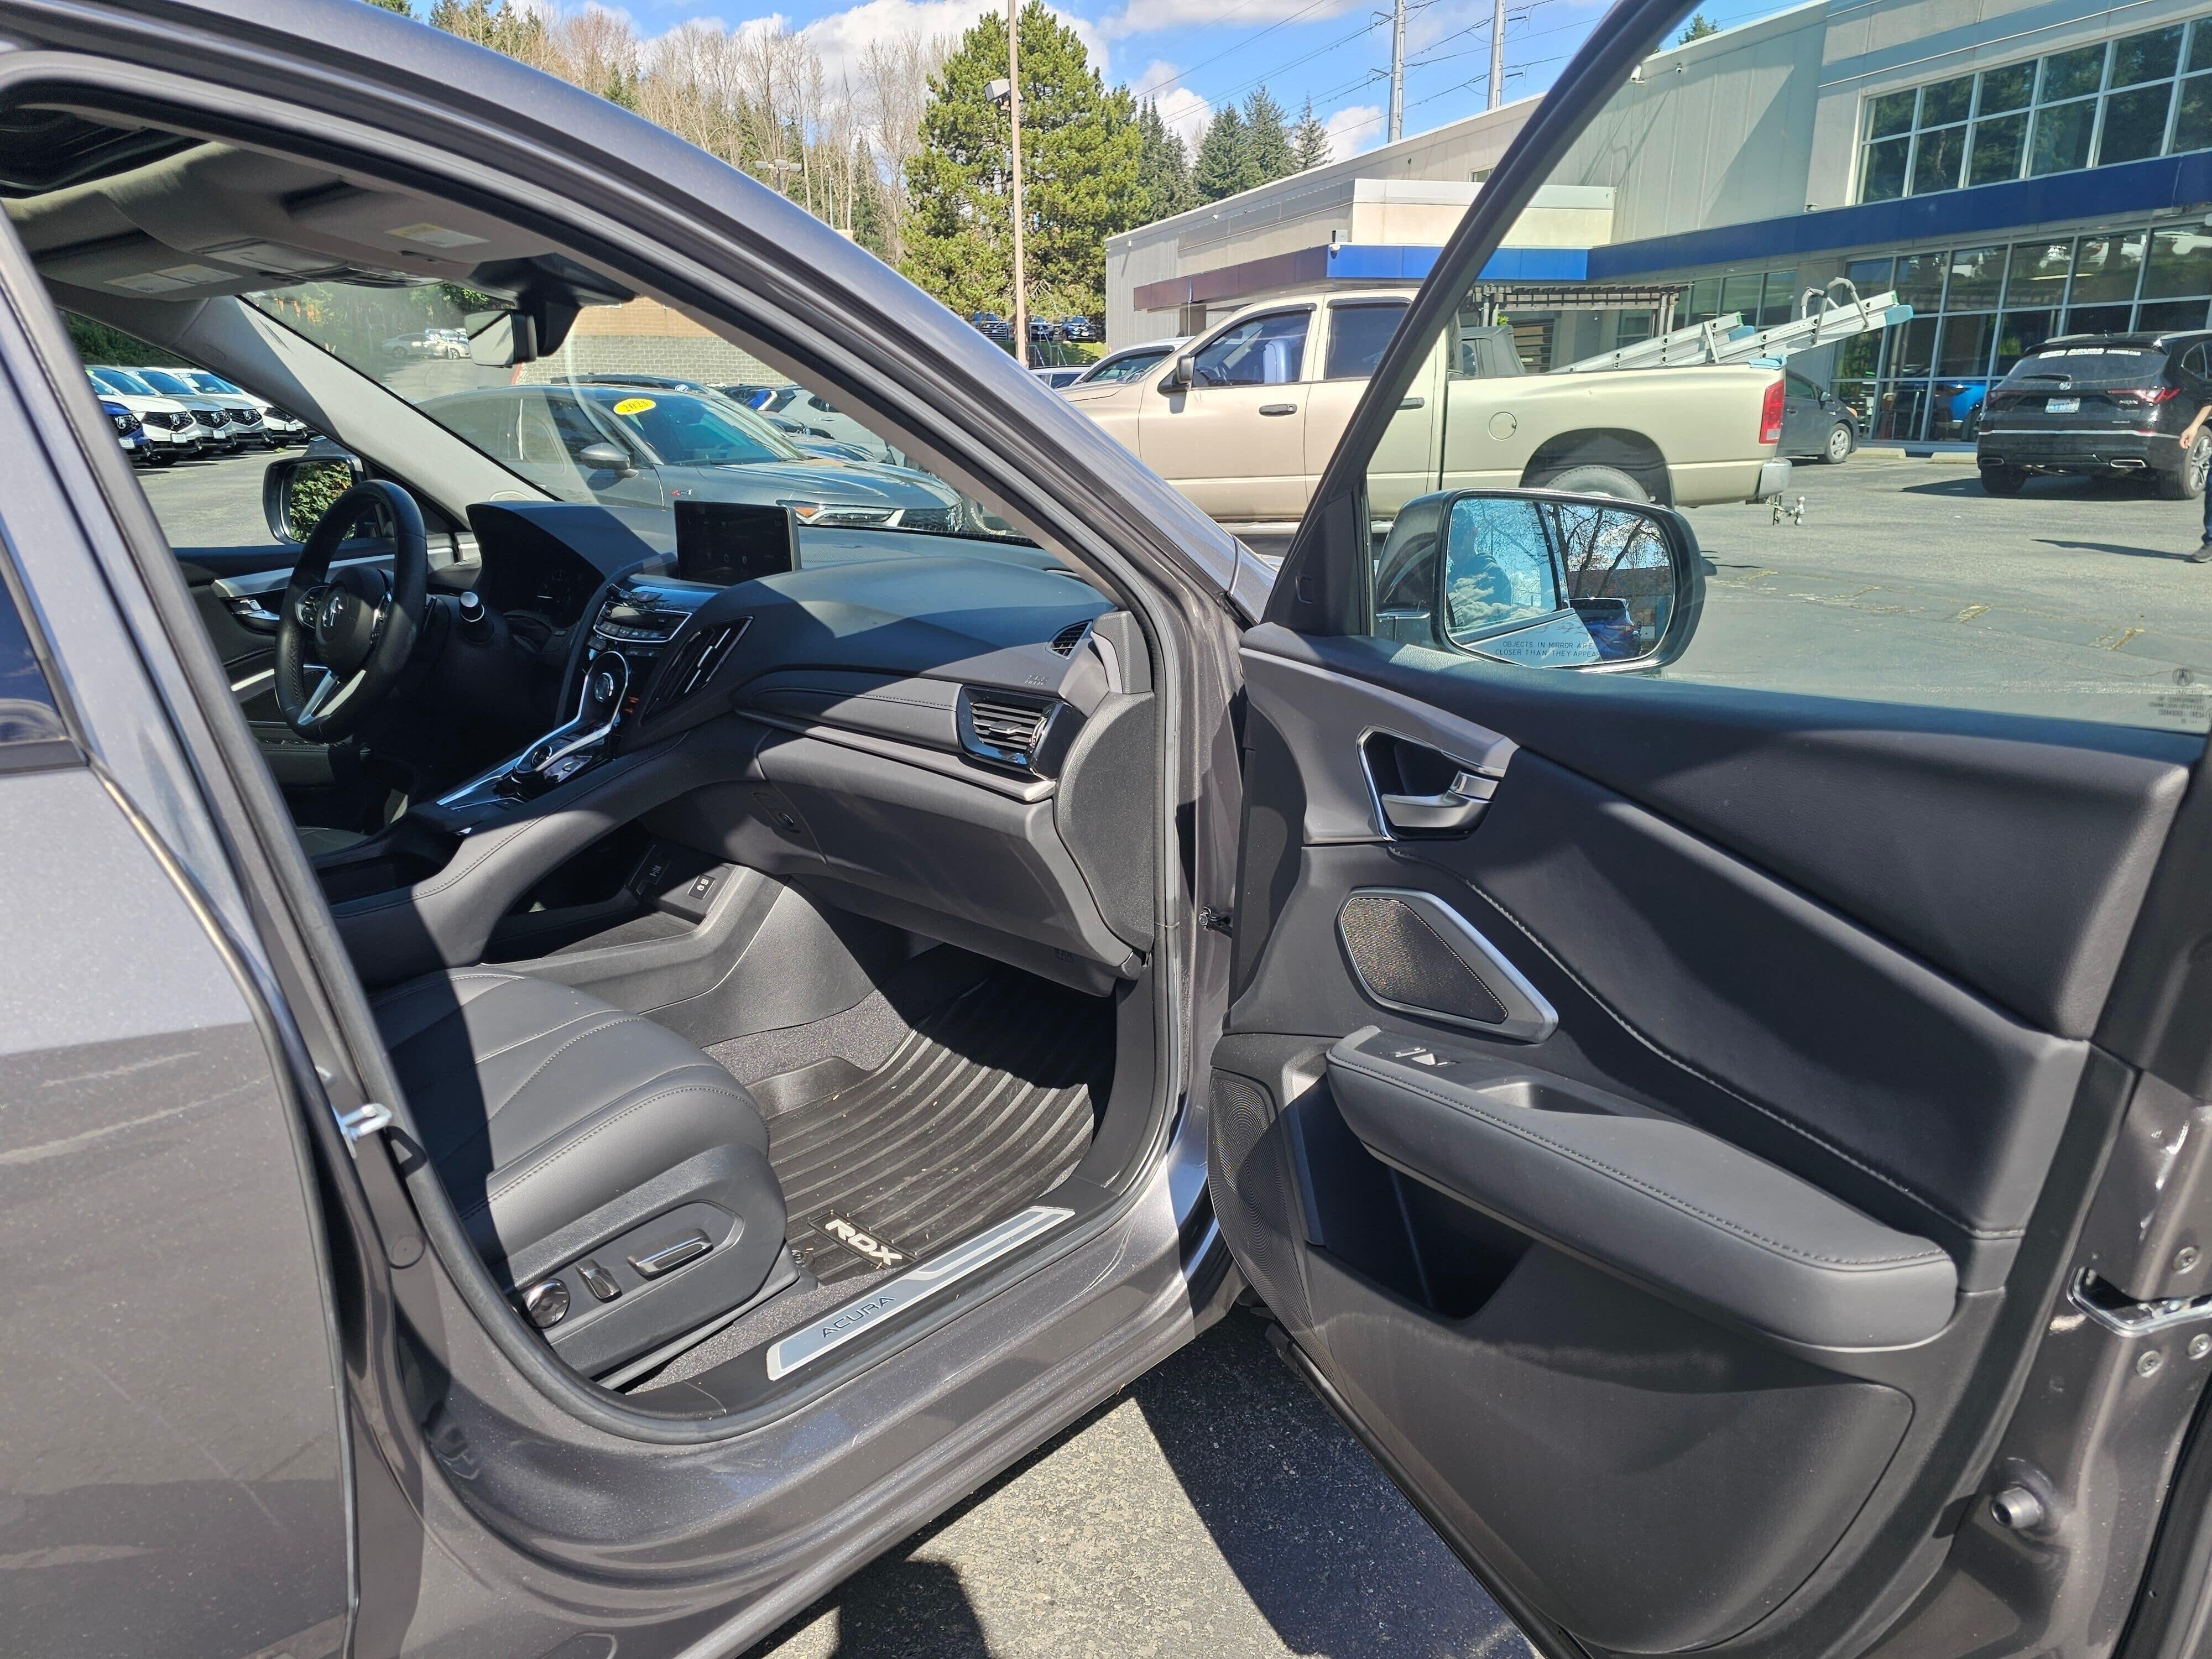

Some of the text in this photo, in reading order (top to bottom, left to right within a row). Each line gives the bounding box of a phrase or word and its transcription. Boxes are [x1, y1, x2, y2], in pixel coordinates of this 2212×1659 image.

[623, 400, 649, 412] 2023
[824, 1218, 903, 1266] RDX
[822, 1296, 896, 1338] ACURA
